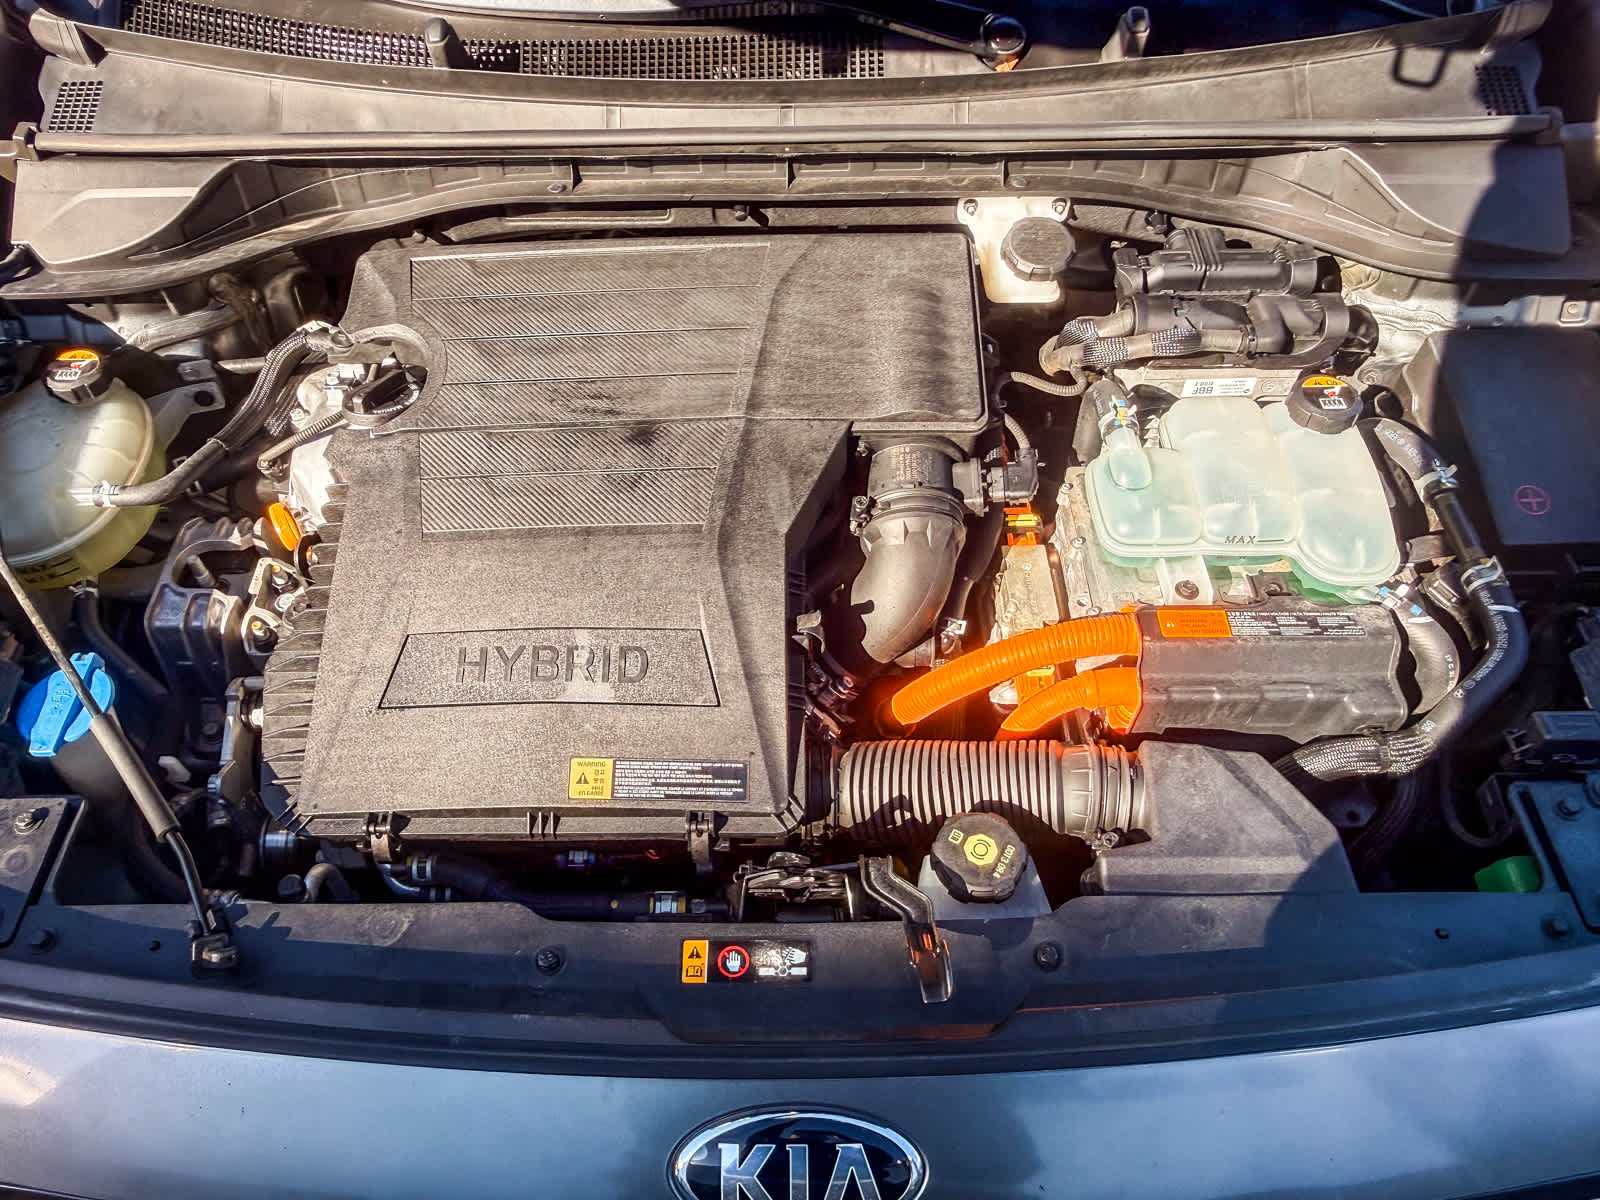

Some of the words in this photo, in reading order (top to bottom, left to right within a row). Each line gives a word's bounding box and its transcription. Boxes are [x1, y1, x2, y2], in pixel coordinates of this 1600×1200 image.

[1224, 535, 1257, 545] MAX
[455, 645, 649, 684] HYBRID
[718, 1143, 882, 1200] KIA
